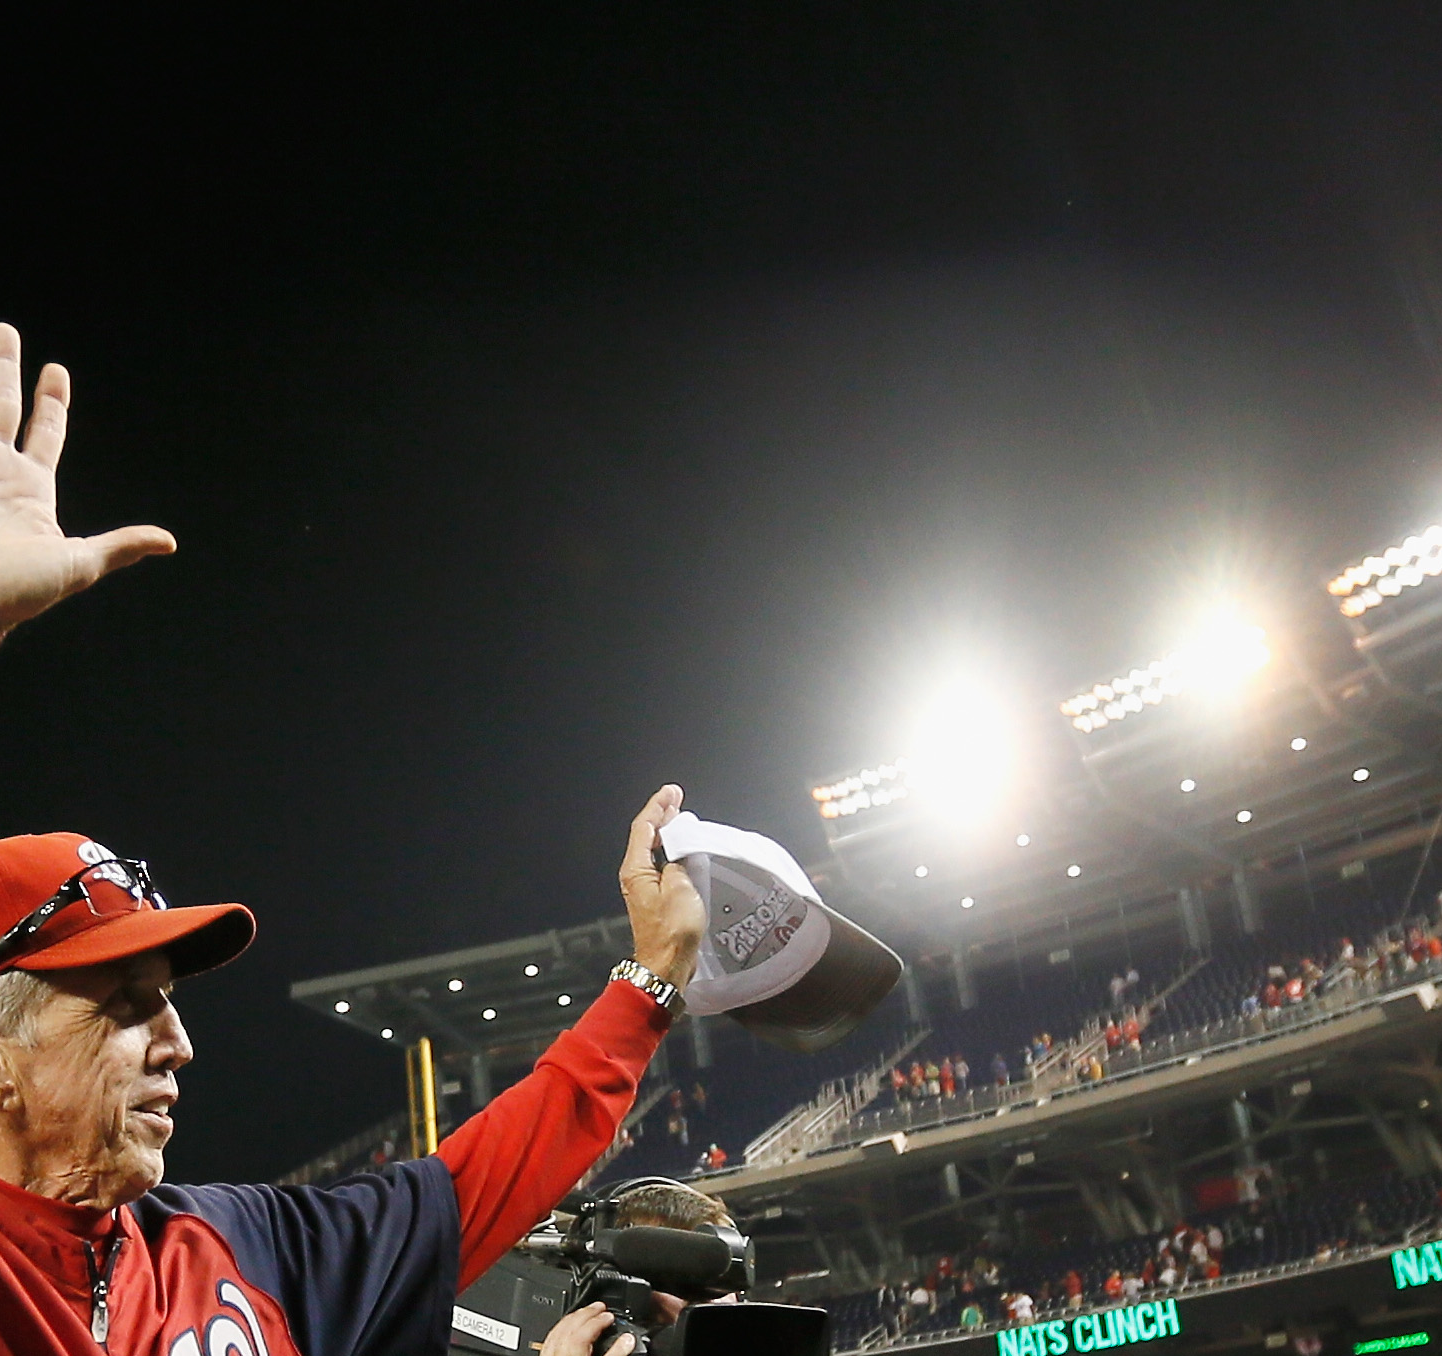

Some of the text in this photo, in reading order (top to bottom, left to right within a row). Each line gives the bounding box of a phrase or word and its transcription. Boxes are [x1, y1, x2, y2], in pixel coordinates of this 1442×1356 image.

[462, 1316, 493, 1336] CAMERA
[495, 1328, 506, 1341] 12
[1072, 1298, 1180, 1352] CLINCH
